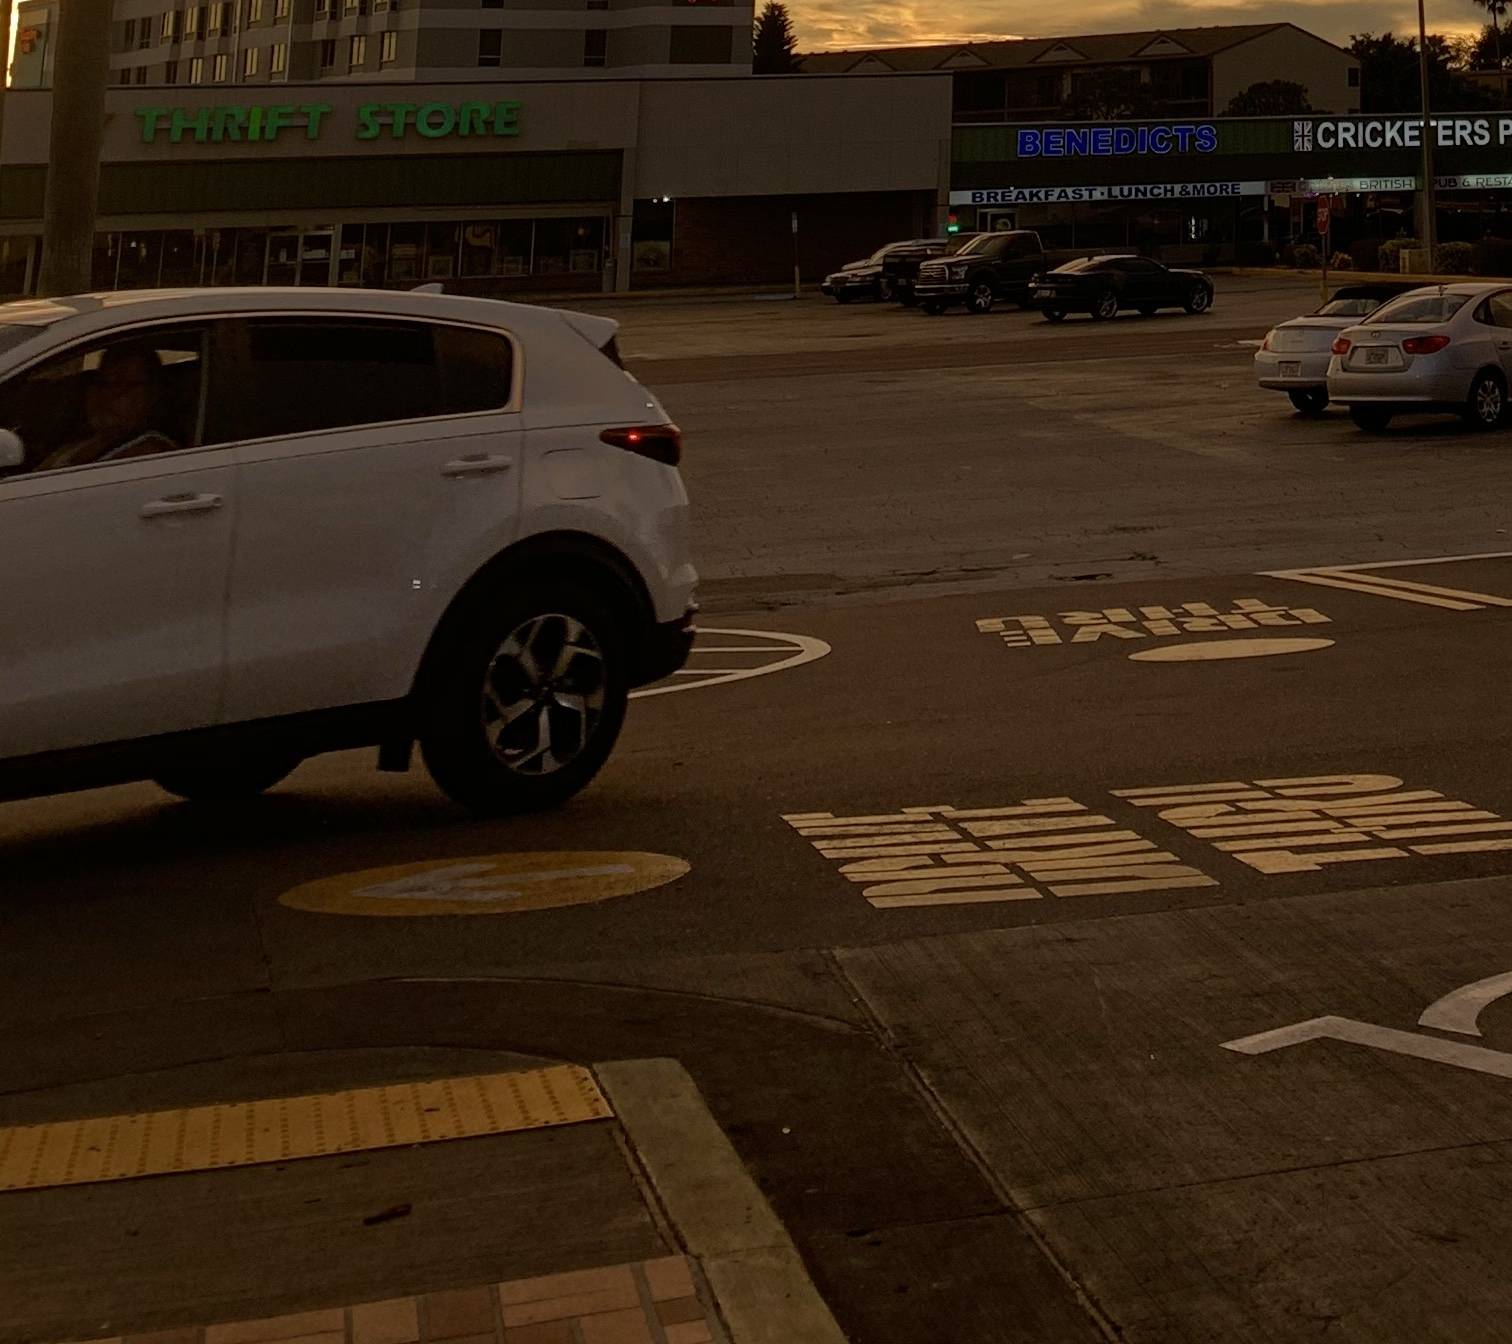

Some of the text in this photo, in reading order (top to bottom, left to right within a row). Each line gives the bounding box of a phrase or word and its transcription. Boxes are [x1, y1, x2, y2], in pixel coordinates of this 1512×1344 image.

[135, 100, 521, 144] THRIFT STORE
[1316, 119, 1491, 149] CRICKEERS
[1016, 124, 1218, 158] BENEDICTS
[971, 187, 1097, 204] BREAKFAST
[1107, 185, 1175, 200] LUNCH
[1360, 179, 1413, 190] BRITISH
[975, 598, 1288, 633] THRU
[999, 607, 1333, 649] DRIVE
